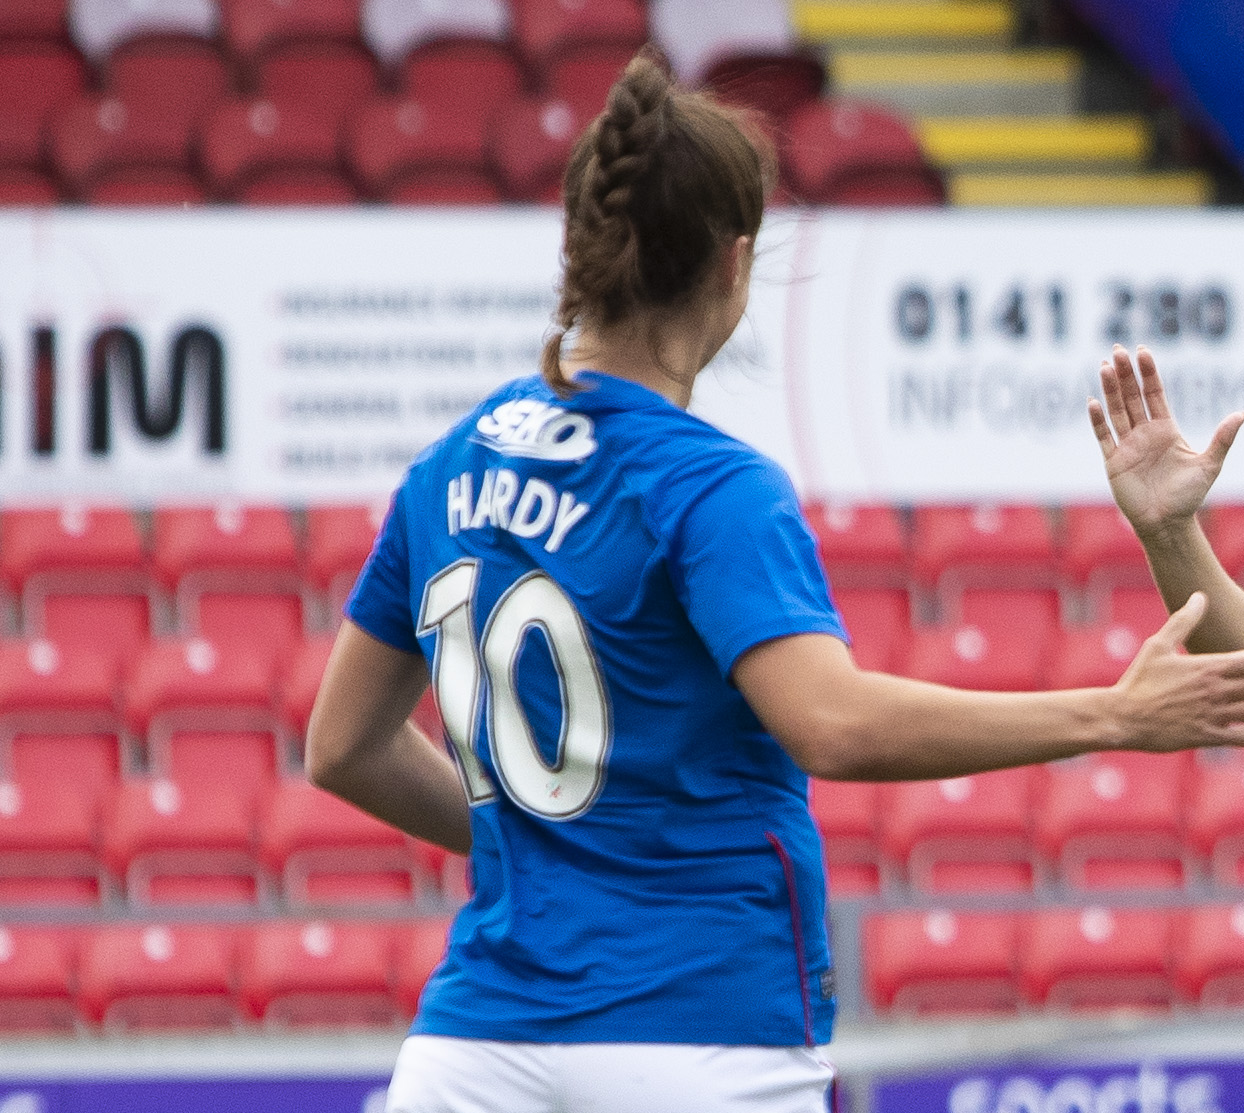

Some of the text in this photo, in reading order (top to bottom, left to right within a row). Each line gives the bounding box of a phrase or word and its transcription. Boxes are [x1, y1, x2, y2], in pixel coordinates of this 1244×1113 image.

[893, 279, 1068, 346] 0141
[1102, 279, 1233, 346] 280
[0, 320, 226, 458] IM
[476, 399, 598, 460] SEKO
[447, 469, 589, 554] HARDY
[416, 556, 613, 822] 10
